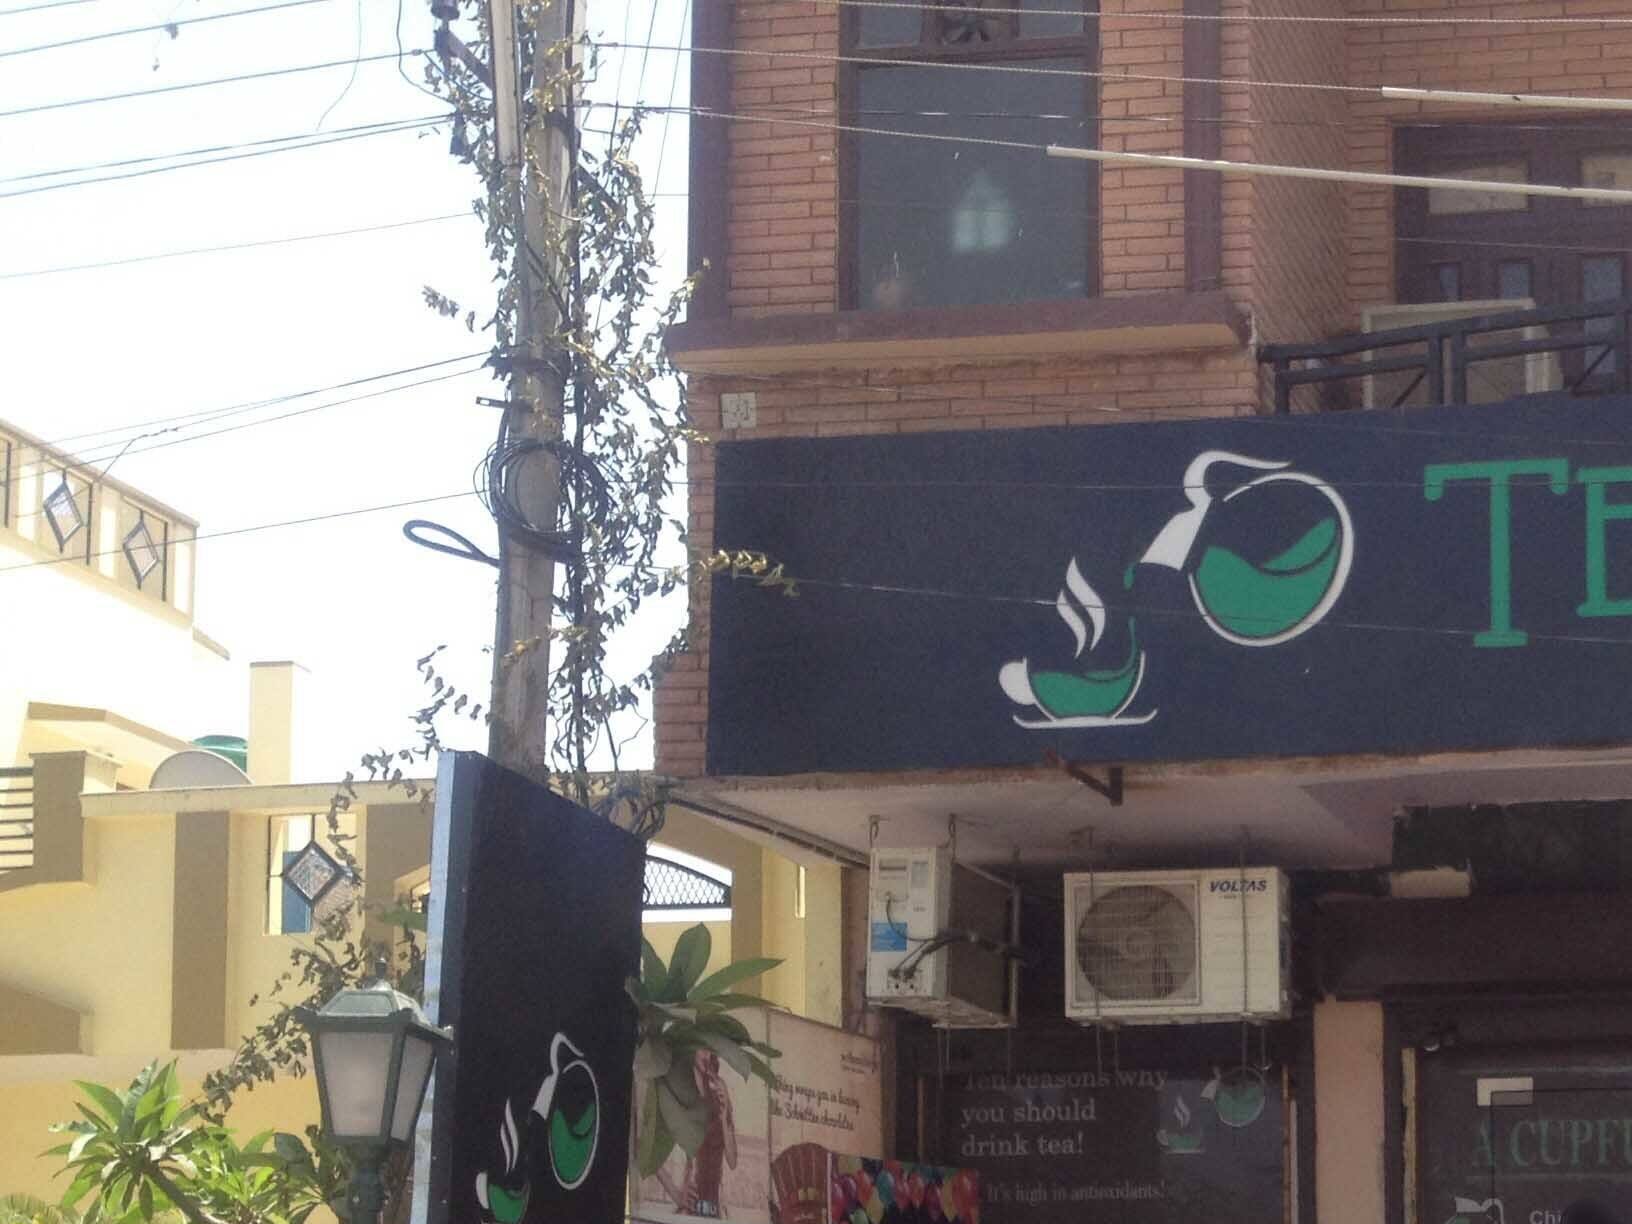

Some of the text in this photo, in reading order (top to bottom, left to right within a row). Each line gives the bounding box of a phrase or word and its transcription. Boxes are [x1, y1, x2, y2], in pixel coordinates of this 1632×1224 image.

[1209, 880, 1267, 892] VOLTAS
[961, 1096, 1097, 1129] you should
[961, 1130, 1085, 1157] drink tea!
